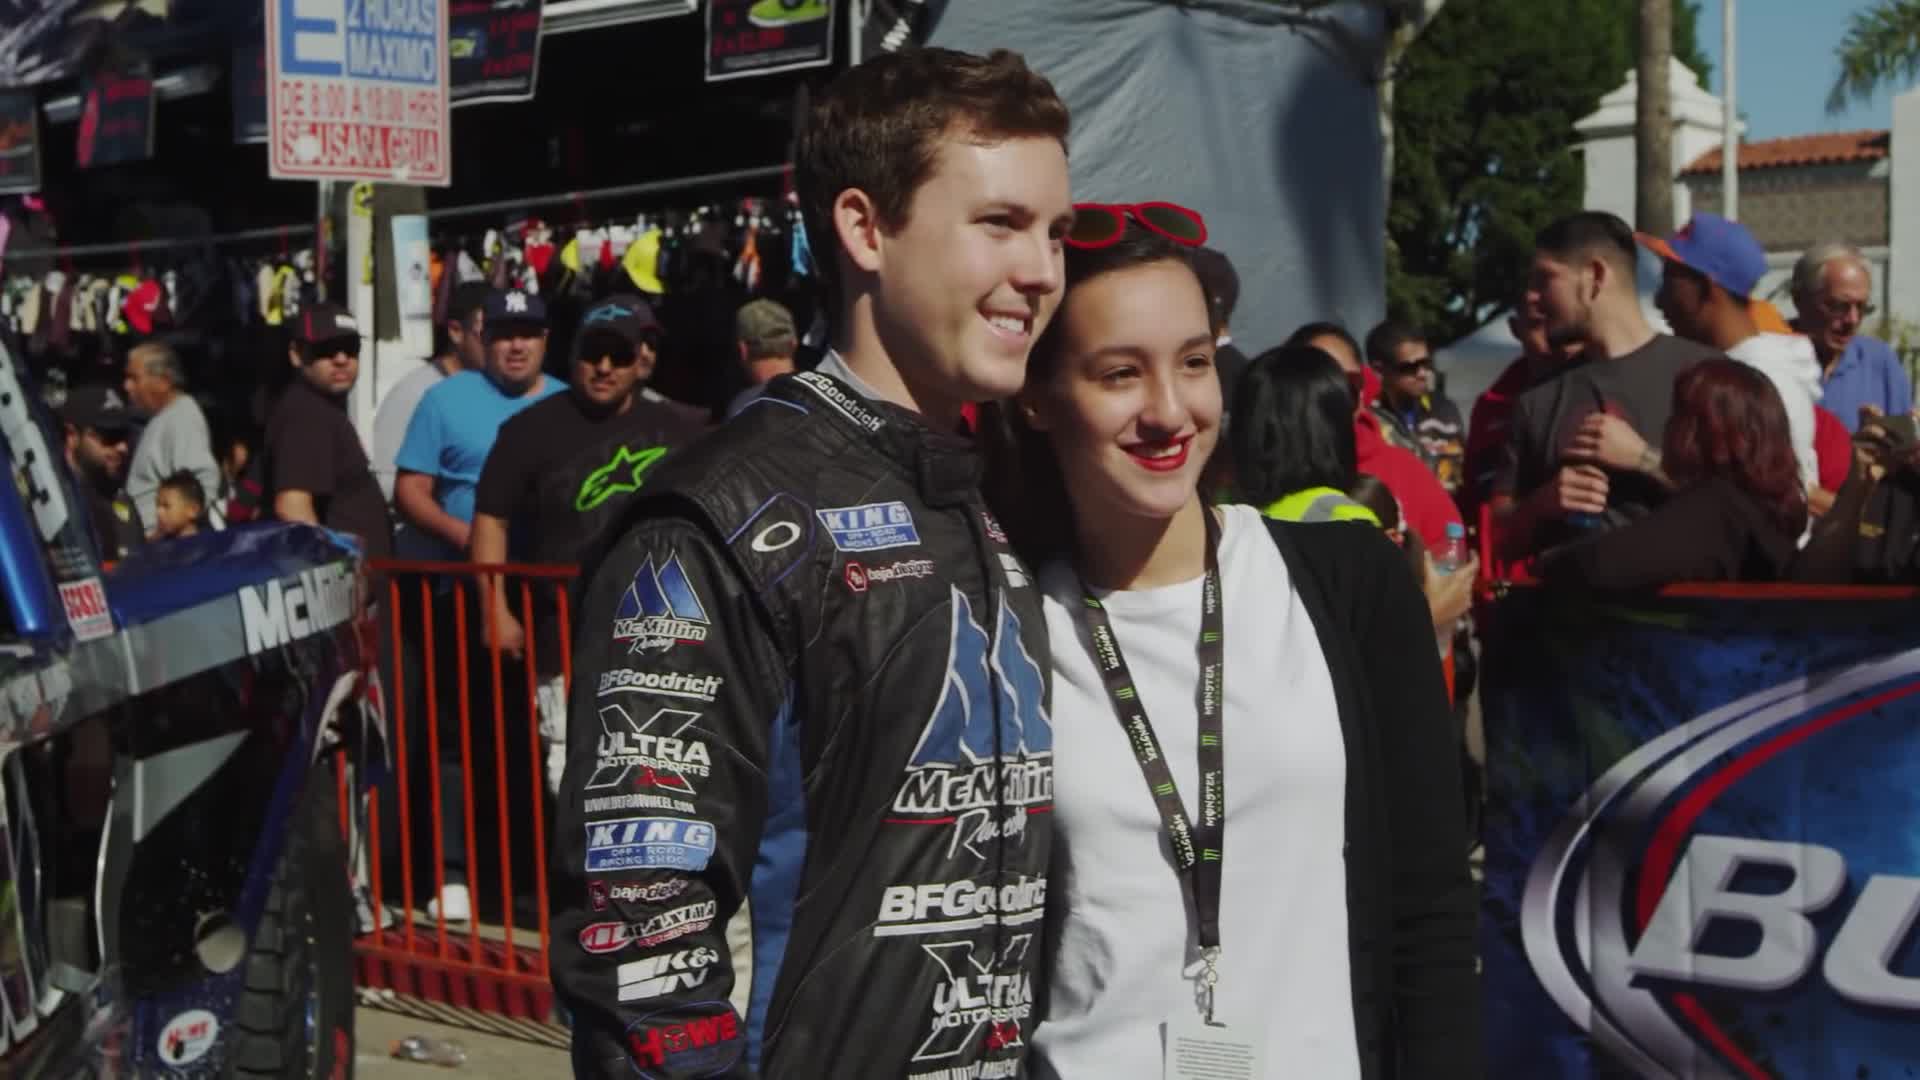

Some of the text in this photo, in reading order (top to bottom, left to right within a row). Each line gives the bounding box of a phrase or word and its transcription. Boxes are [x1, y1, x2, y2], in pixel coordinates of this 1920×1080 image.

[366, 0, 435, 37] HORAS
[349, 32, 434, 83] MAXIMO
[281, 80, 304, 117] DE
[798, 370, 881, 432] BFGoodrich
[826, 504, 909, 530] KING
[1096, 624, 1121, 670] MONSTER
[600, 668, 718, 695] BFGoodrich
[1203, 664, 1216, 716] MONSTER
[597, 731, 712, 767] ULTRA
[1131, 714, 1158, 762] MONSTER
[597, 755, 711, 778] MOTORSPORTS
[1205, 770, 1217, 827] MONSTER
[591, 821, 712, 848] KING
[1172, 813, 1195, 867] MONSTER
[878, 872, 1047, 921] BFGoodric
[932, 970, 1032, 1014] ULTRA
